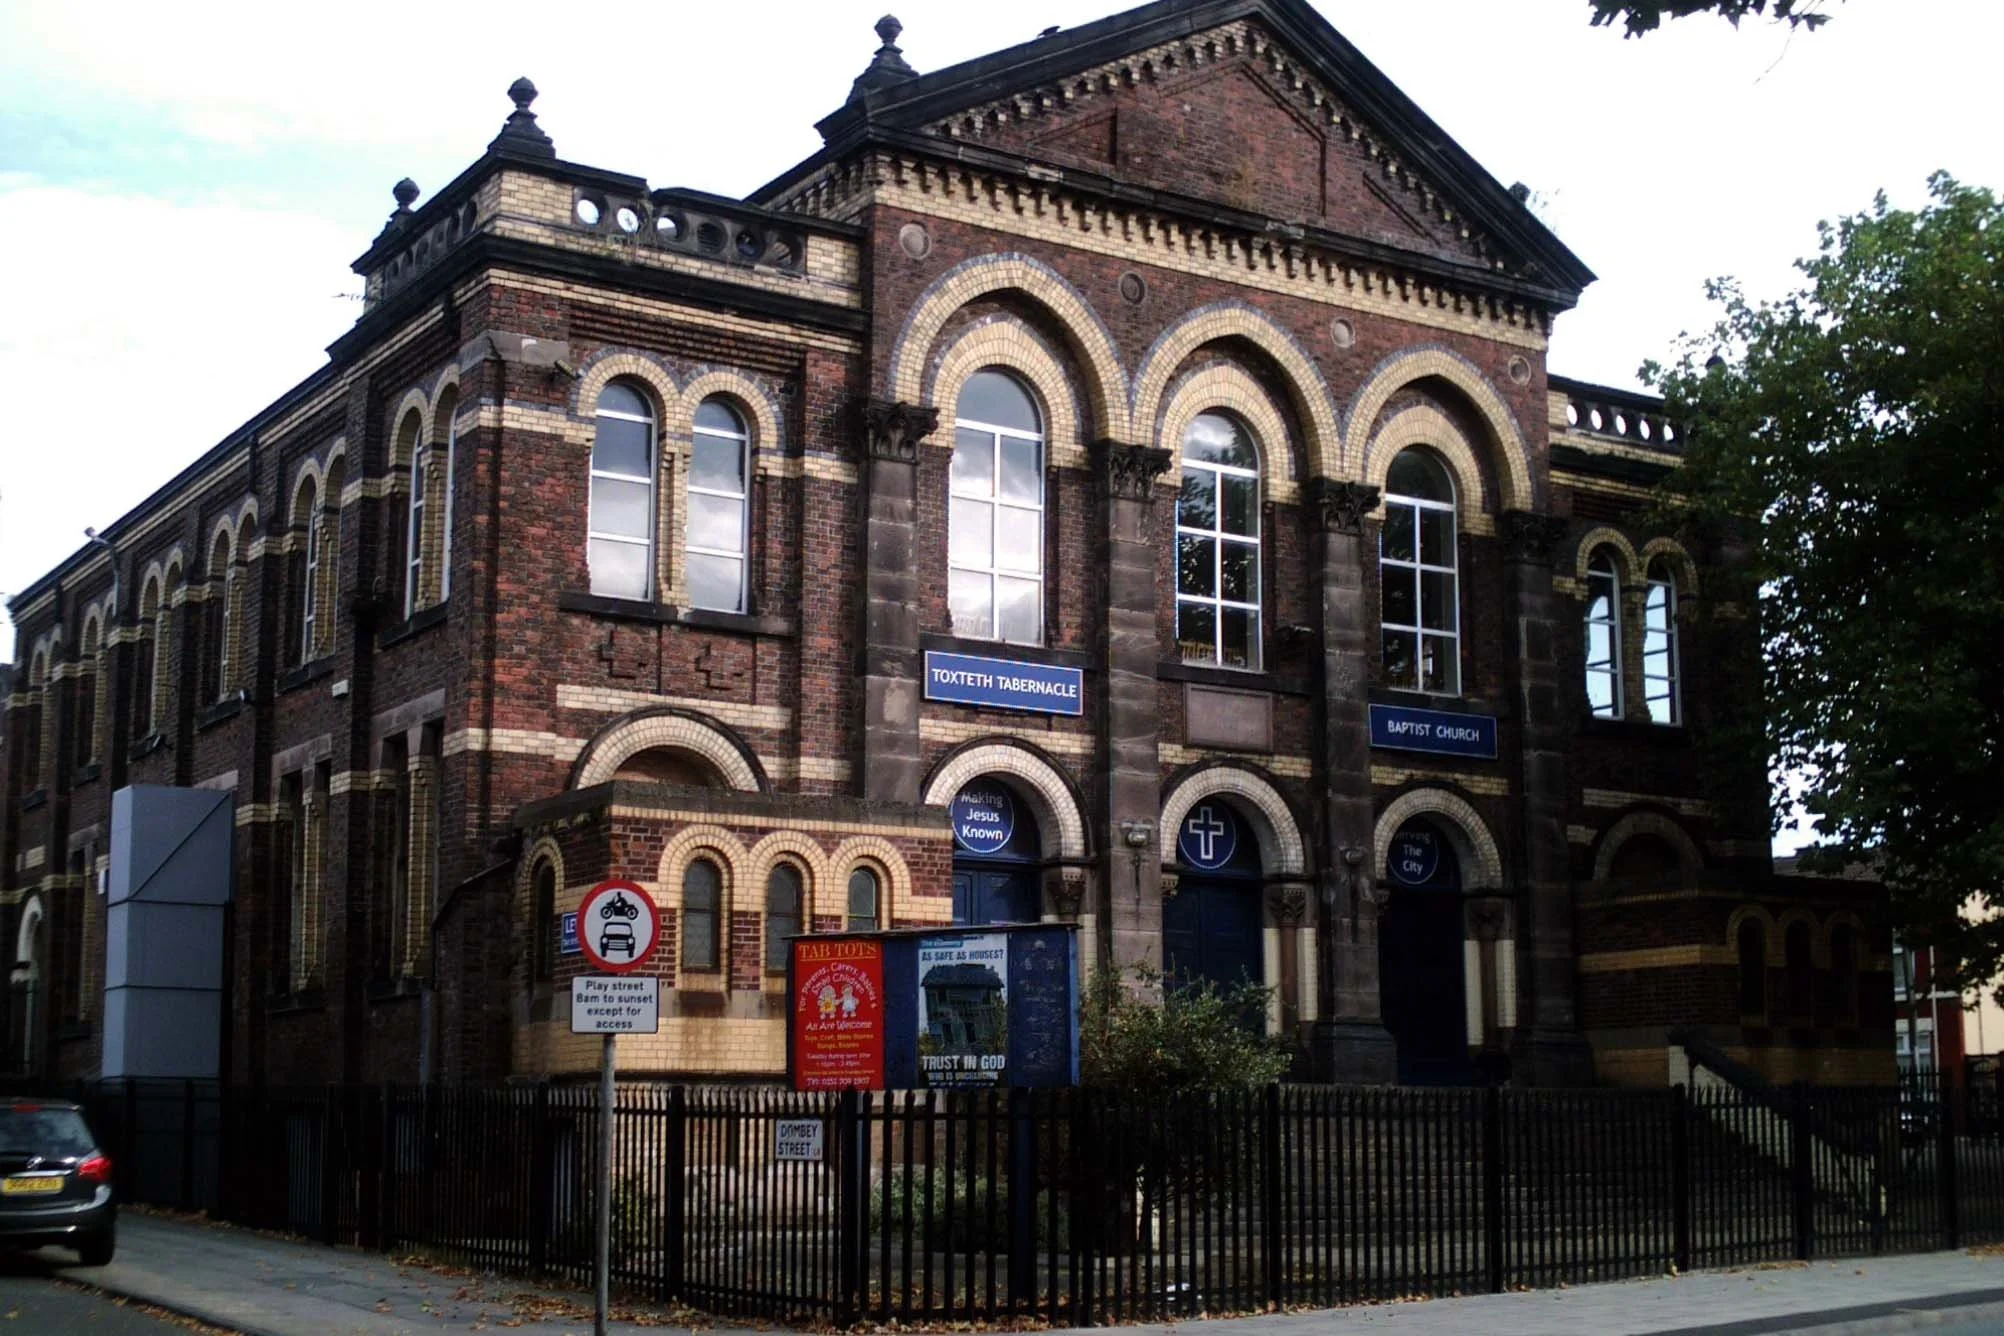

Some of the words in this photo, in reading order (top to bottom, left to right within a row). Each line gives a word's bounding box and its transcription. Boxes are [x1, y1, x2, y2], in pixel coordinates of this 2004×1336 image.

[932, 668, 993, 689] TOXTETH
[997, 675, 1077, 698] TABERNACLE
[1388, 719, 1431, 737] BAPTIST
[1436, 725, 1480, 742] CHURCH
[961, 791, 1004, 808] Making
[966, 808, 1000, 822] Jesus
[962, 824, 1003, 840] Known
[1403, 843, 1422, 857] The
[1402, 859, 1424, 875] City
[799, 944, 831, 959] TAB
[835, 942, 877, 957] TOTS
[922, 951, 932, 961] AS
[934, 951, 953, 961] SAFE
[956, 951, 967, 960] AS
[969, 949, 1004, 960] HOUSES?
[585, 981, 608, 993] Play
[612, 981, 644, 991] street
[576, 993, 600, 1004] 8am
[603, 993, 615, 1004] to
[619, 993, 653, 1004] sunset
[586, 1007, 623, 1018] except
[626, 1006, 642, 1017] for
[595, 1020, 633, 1029] access
[922, 1055, 960, 1071] TRUST
[963, 1055, 977, 1070] IN
[981, 1054, 1006, 1070] GOD
[780, 1124, 818, 1138] DOMBEY
[778, 1142, 812, 1156] STREET
